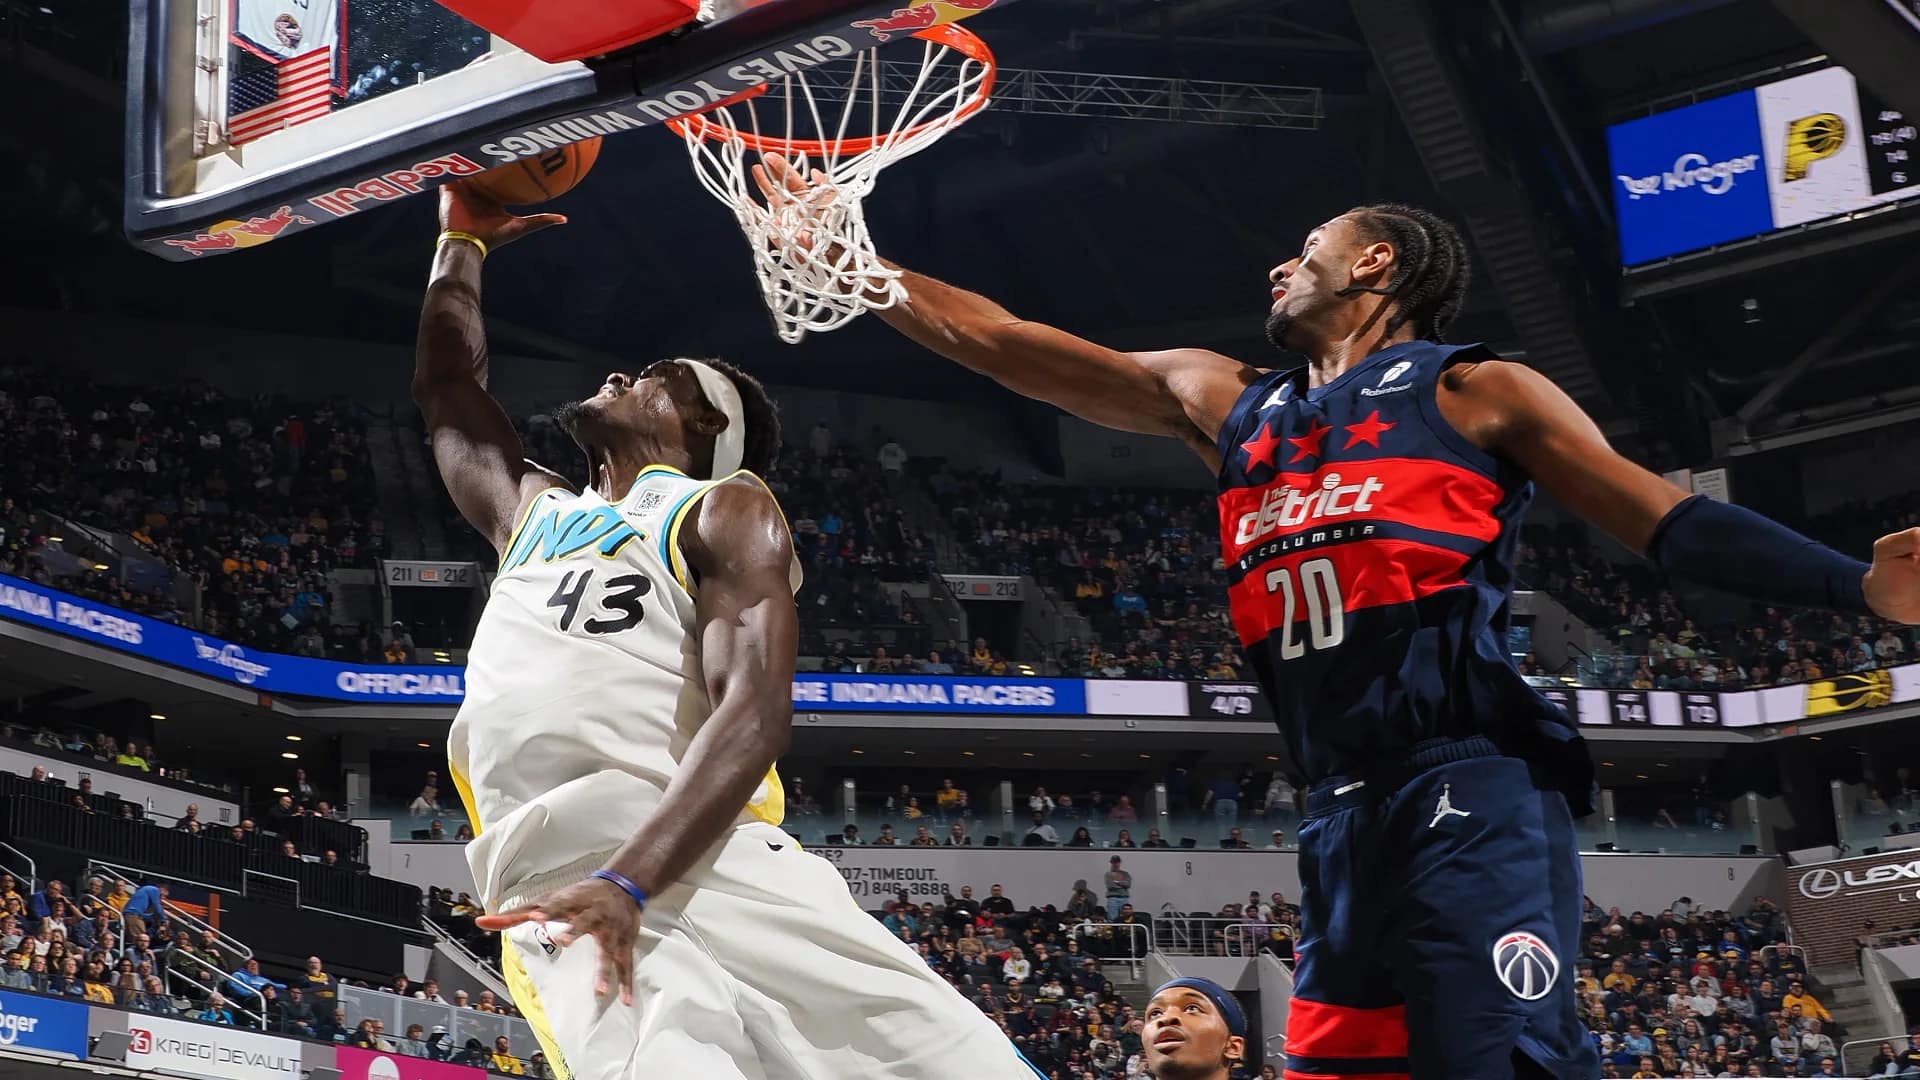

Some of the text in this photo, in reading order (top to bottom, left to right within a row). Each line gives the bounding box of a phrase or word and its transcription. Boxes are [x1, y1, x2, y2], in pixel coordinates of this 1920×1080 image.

[727, 35, 853, 86] GIVES
[636, 80, 737, 121] YOU
[1662, 153, 1760, 195] Kroger
[1360, 381, 1413, 397] Robinhood
[1271, 484, 1292, 500] THE
[392, 567, 412, 582] 211
[444, 568, 467, 582] 212
[546, 567, 652, 635] 43
[996, 582, 1017, 597] 213
[1265, 557, 1345, 661] 20
[56, 601, 143, 644] PACERS
[336, 671, 464, 696] OFFICIAL
[791, 681, 1055, 707] HE INDIANA PACERS
[1844, 861, 1920, 886] LEX
[156, 1037, 301, 1073] KRIEG DEVAULT
